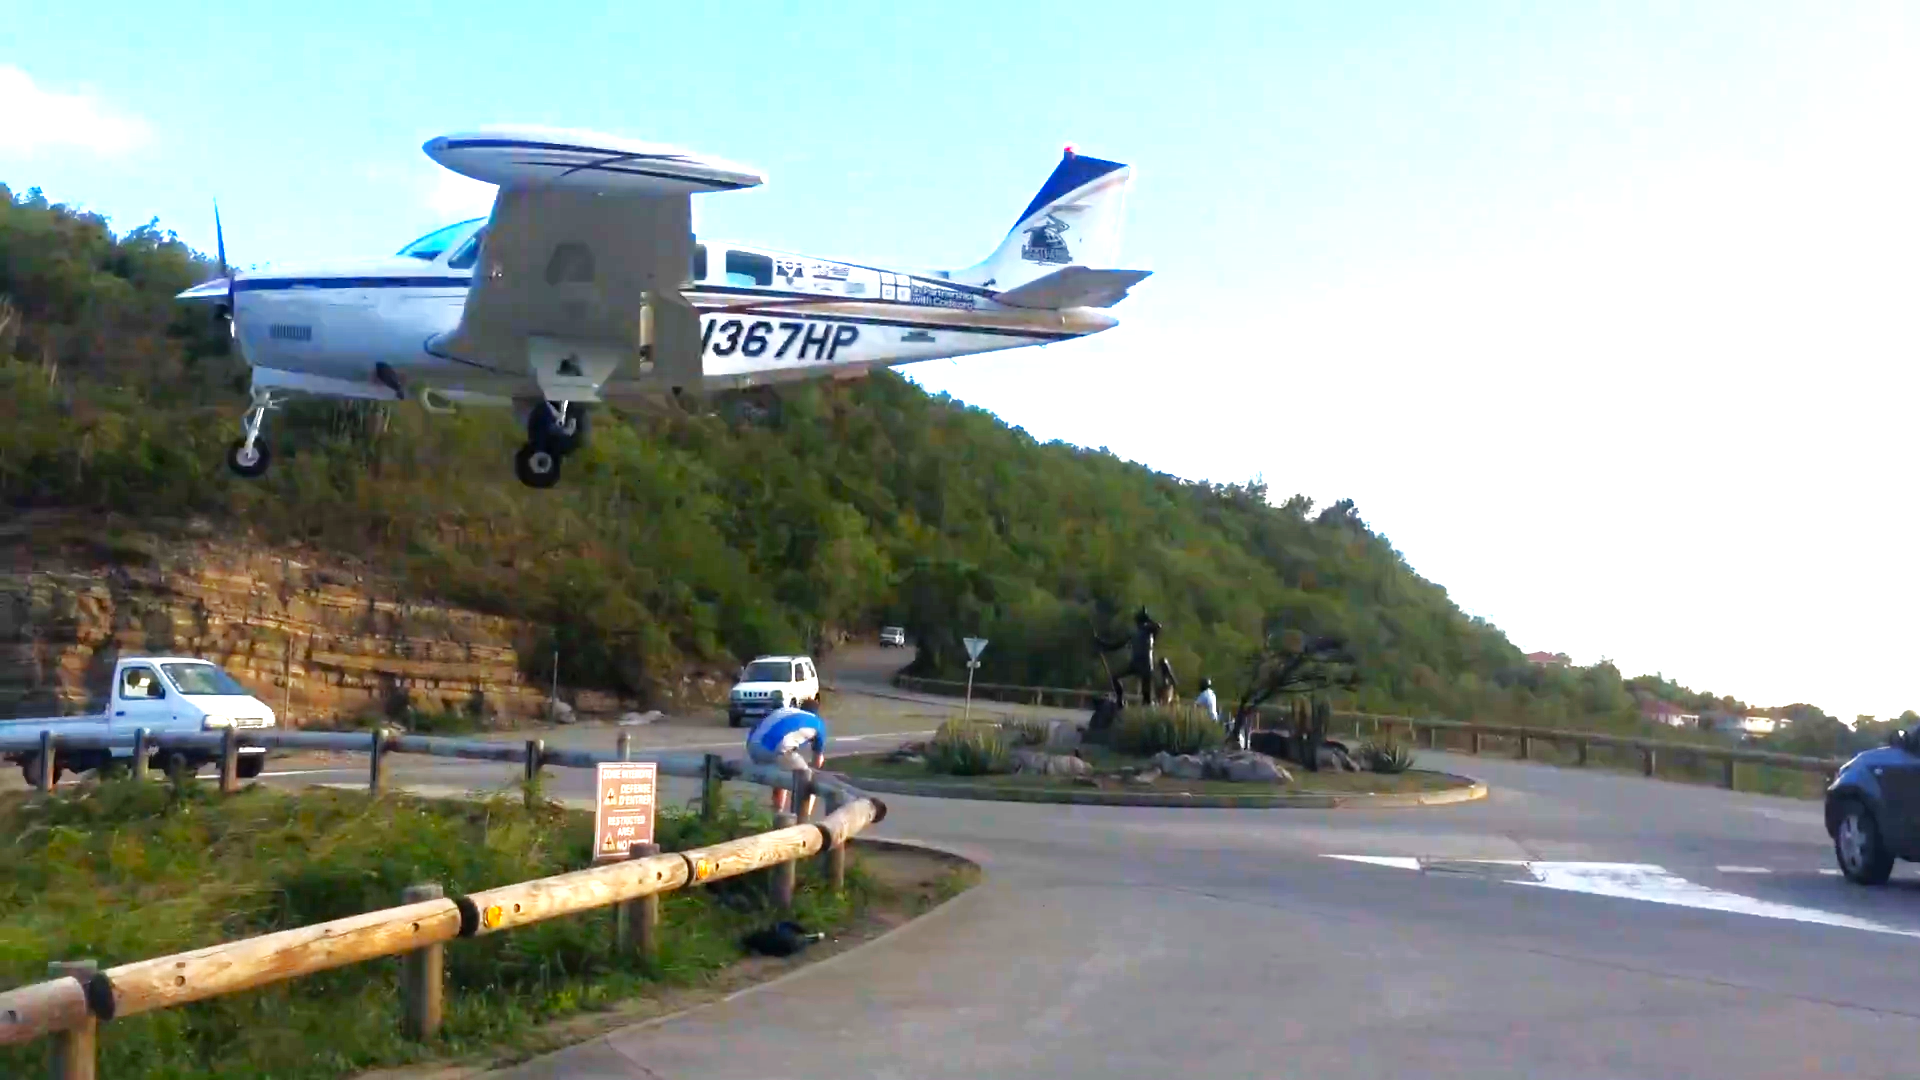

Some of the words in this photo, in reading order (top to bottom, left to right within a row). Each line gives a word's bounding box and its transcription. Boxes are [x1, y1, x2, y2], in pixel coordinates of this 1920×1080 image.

[607, 815, 646, 826] RESTRICTED
[617, 827, 635, 836] AREA
[616, 840, 627, 850] NO
